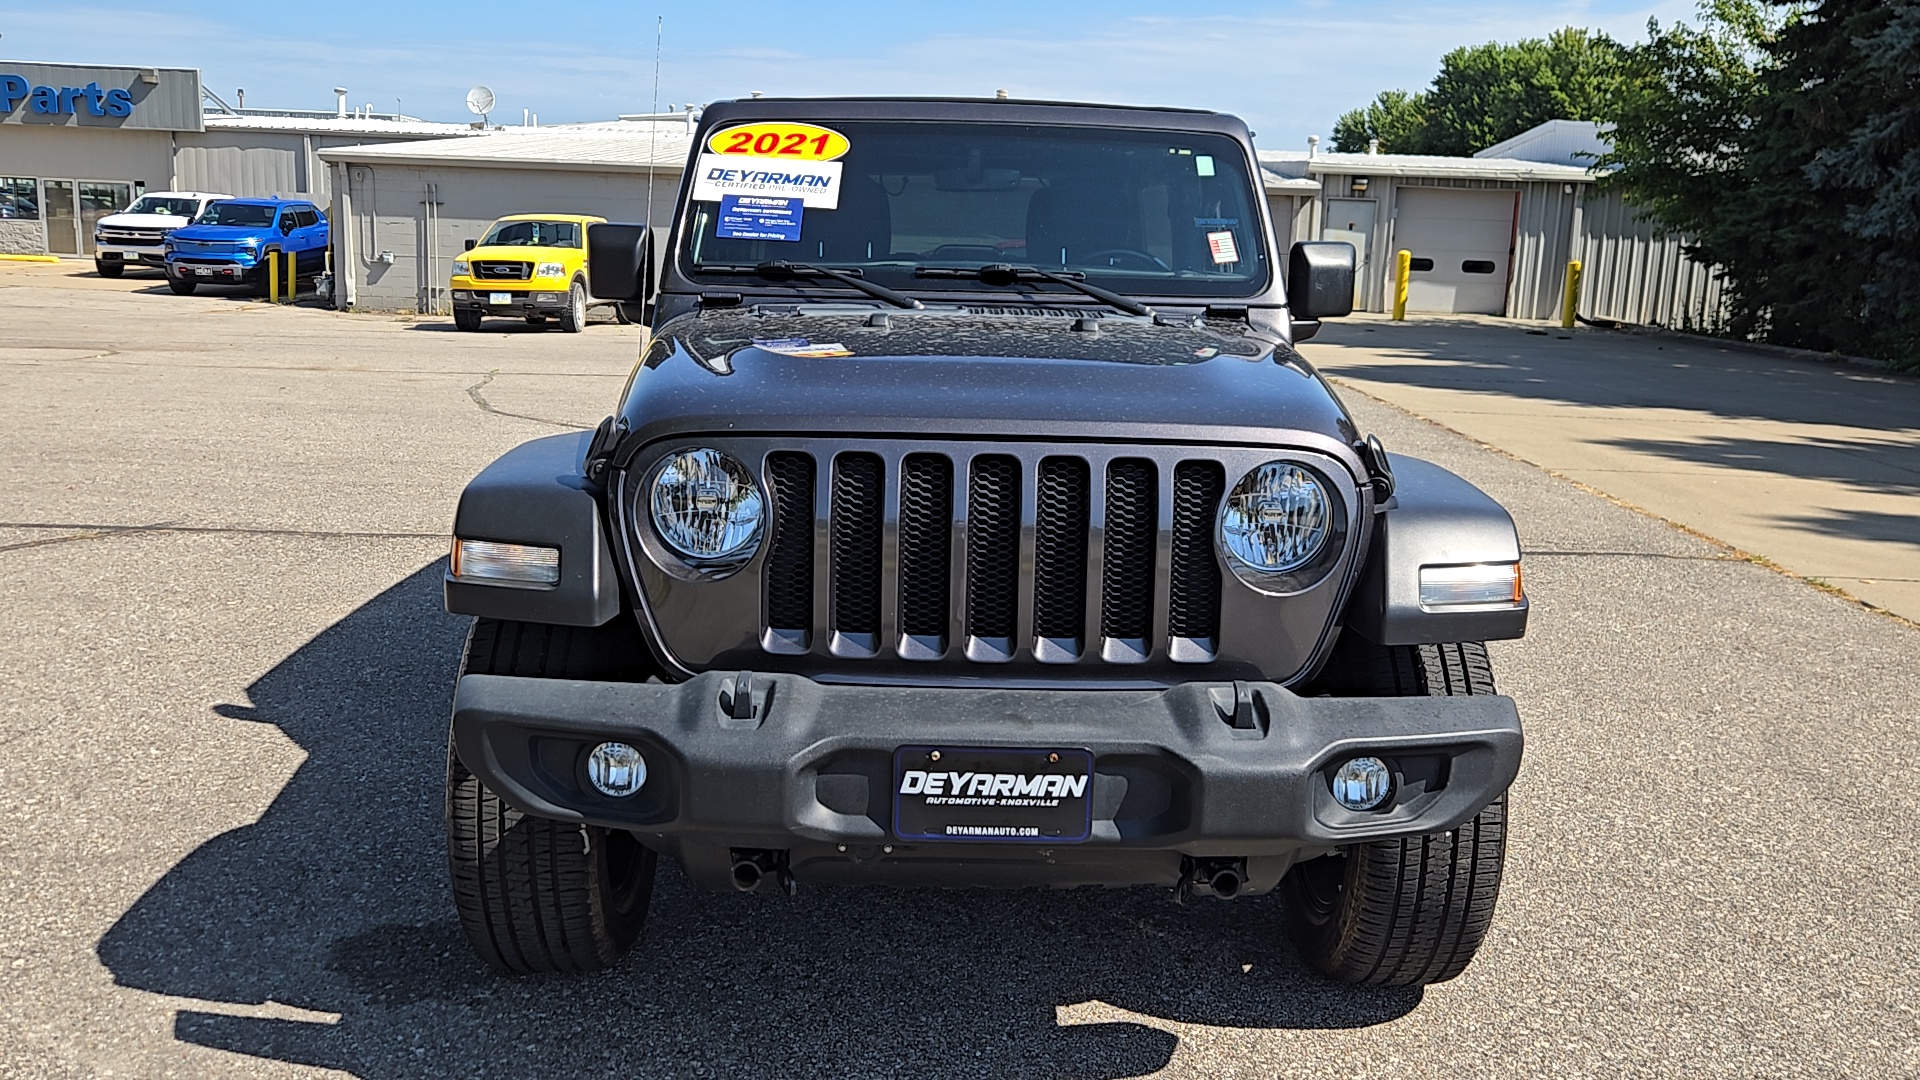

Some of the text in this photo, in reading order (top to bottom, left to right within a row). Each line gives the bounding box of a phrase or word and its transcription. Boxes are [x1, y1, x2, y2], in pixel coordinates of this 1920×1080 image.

[0, 74, 133, 117] Parts
[722, 132, 831, 156] 2021
[706, 167, 832, 188] DEYARMAN
[714, 180, 827, 194] CERTIFIED PRE-OWNED
[899, 770, 1089, 798] DEYARMAN
[925, 796, 1060, 807] AUTOMOTIVE-KNOXVILLE
[946, 825, 1039, 837] DEYARMANAUTO.COM
